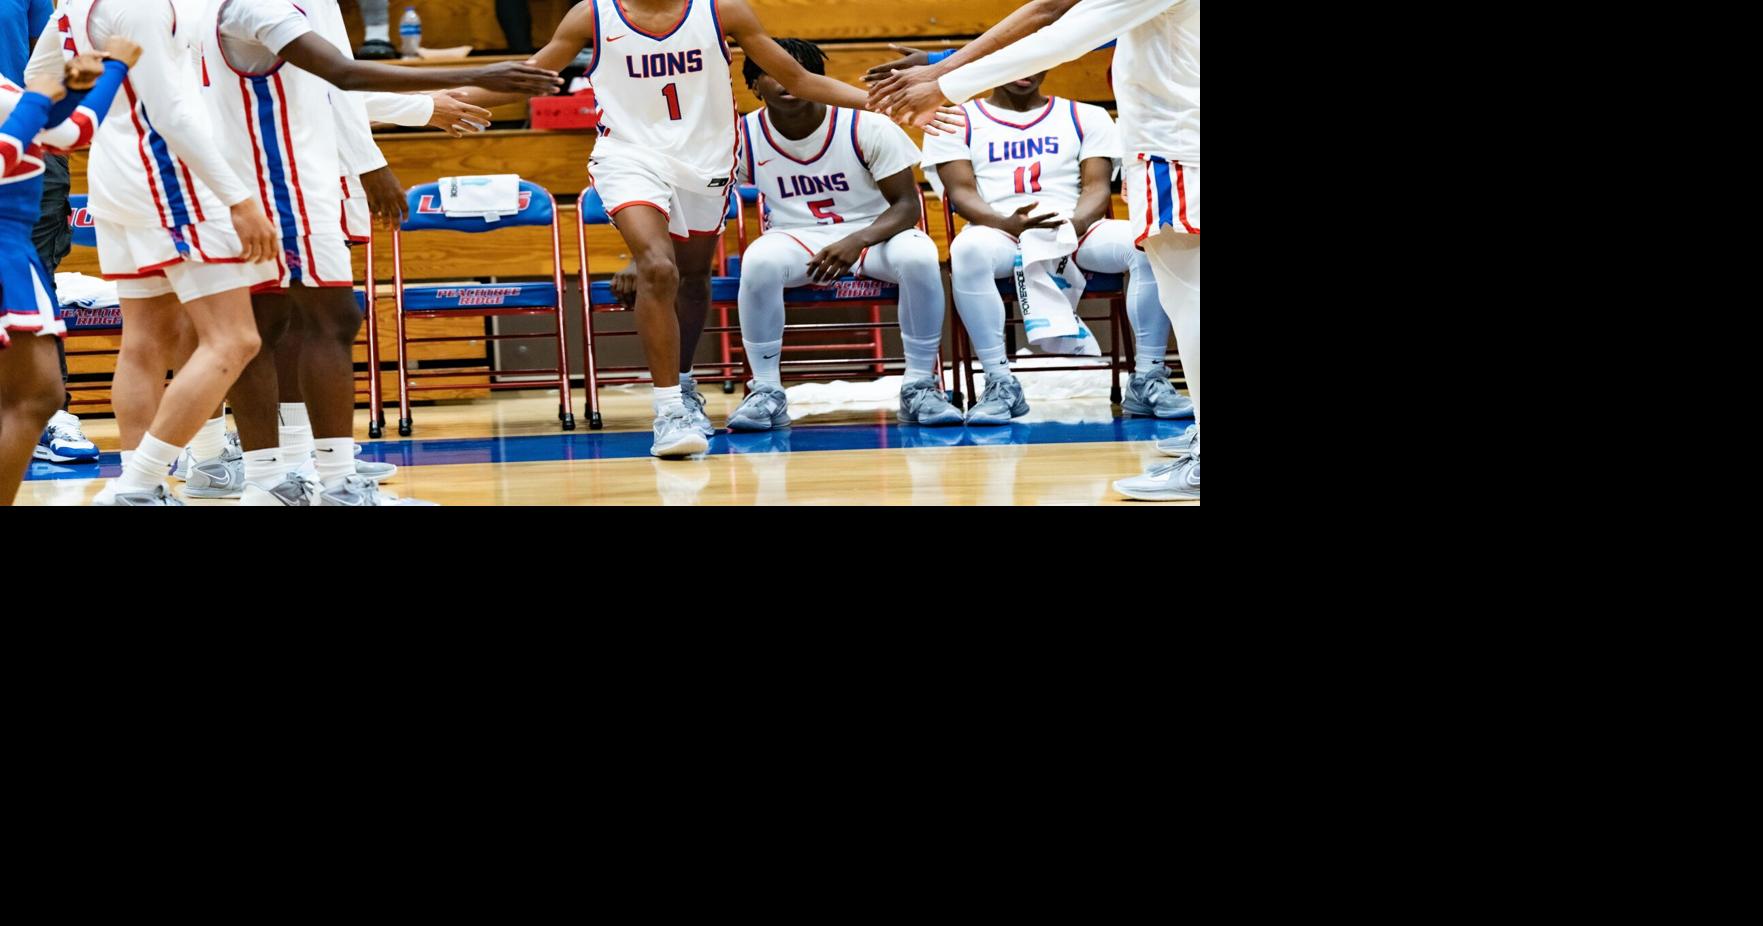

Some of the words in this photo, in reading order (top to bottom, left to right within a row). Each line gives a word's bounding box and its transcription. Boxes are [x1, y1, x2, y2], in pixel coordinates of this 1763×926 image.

[626, 49, 703, 78] LIONS
[661, 82, 682, 121] 1
[988, 136, 1059, 163] LIONS
[777, 172, 850, 199] LIONS
[1014, 161, 1042, 194] 11
[807, 198, 845, 224] 5
[435, 288, 522, 298] PEACHTREE
[458, 295, 505, 306] RIDGE
[835, 288, 882, 299] RIDGE
[1015, 270, 1031, 316] POWERADE
